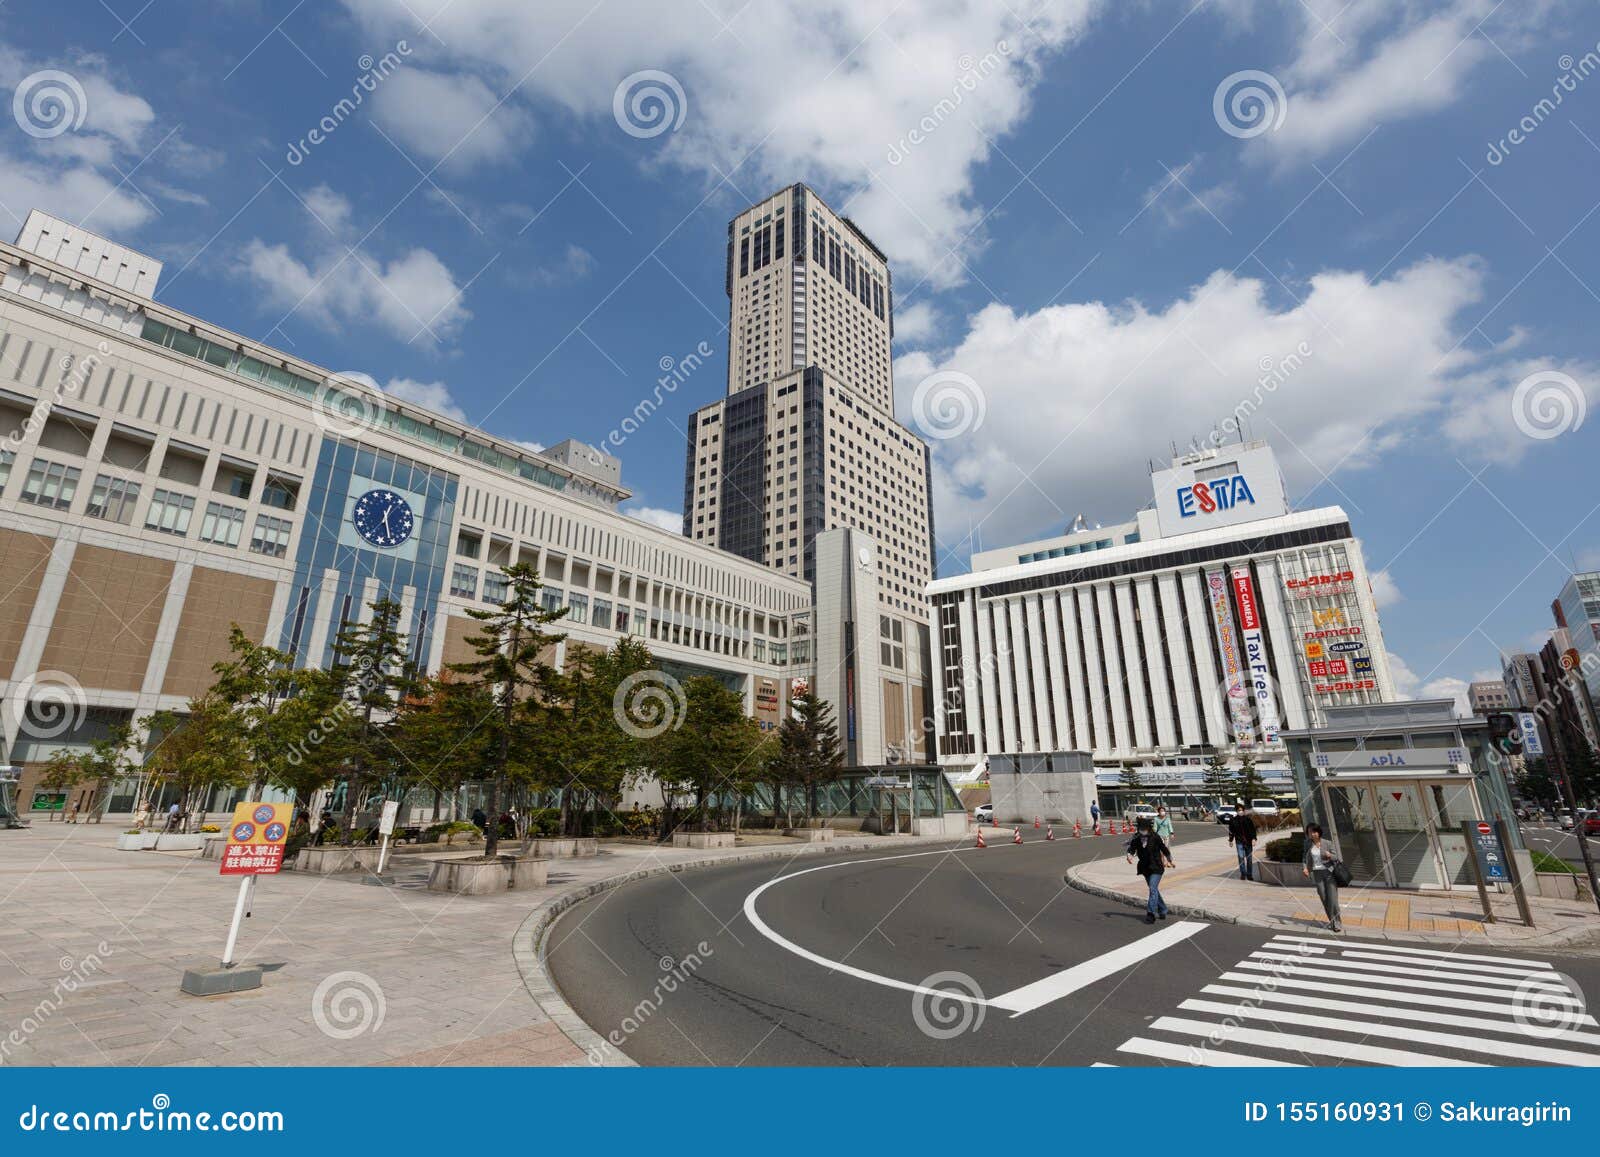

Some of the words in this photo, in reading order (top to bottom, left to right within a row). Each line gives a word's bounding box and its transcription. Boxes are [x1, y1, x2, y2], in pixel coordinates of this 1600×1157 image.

[1177, 474, 1256, 518] ESTA
[1239, 579, 1248, 593] BIC
[1241, 593, 1254, 627] CAMERA
[1304, 627, 1361, 639] namco
[1246, 633, 1261, 662] Tax
[1252, 664, 1268, 699] Free
[1315, 680, 1375, 692] ビックカメラ
[228, 845, 281, 856] 進入禁止
[225, 857, 278, 868] 駐輪禁止
